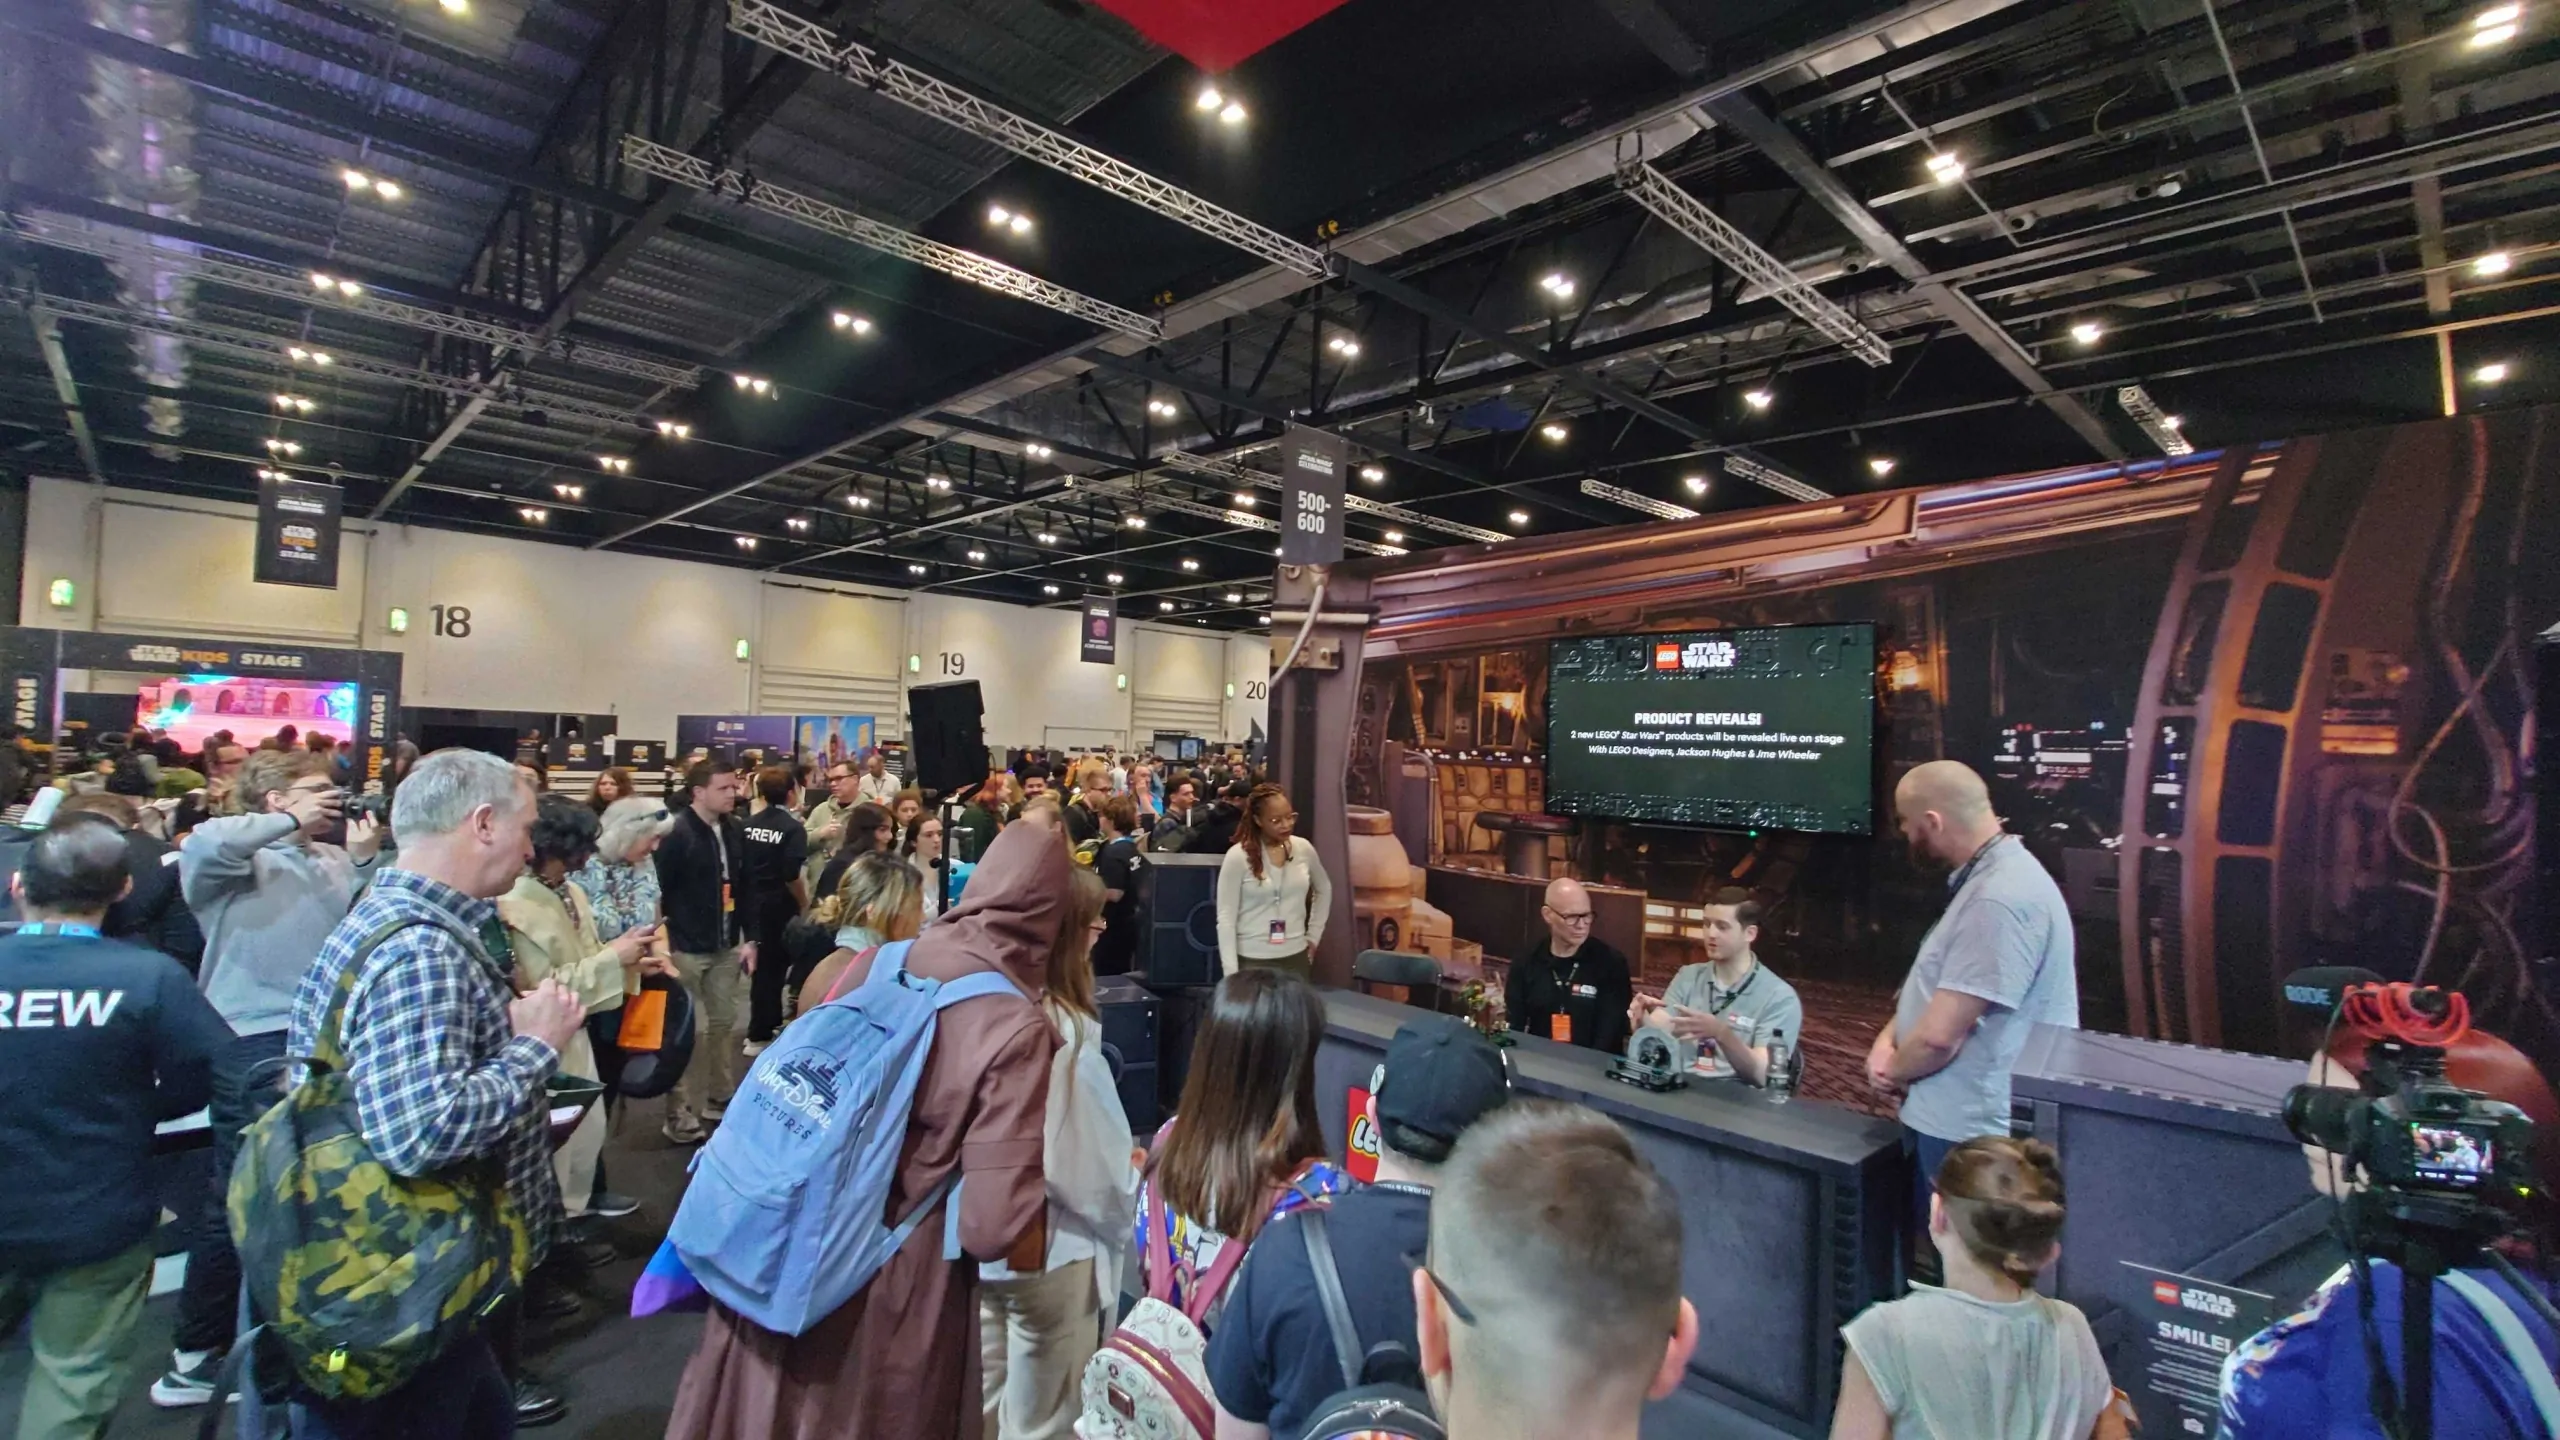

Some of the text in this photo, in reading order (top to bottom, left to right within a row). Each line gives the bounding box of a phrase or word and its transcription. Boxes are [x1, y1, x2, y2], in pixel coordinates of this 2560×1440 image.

[1298, 490, 1332, 513] 500-
[1297, 512, 1325, 534] 600
[430, 604, 471, 638] 18
[181, 650, 230, 663] KIDS
[240, 653, 302, 667] STAGE
[1682, 642, 1735, 656] STAR
[939, 652, 965, 676] 19
[1682, 654, 1735, 668] WARS
[1246, 680, 1267, 700] 20
[15, 678, 37, 729] STAGE
[369, 695, 386, 738] STAGE
[1635, 712, 1762, 725] PRODUCT REVEALS!
[1571, 730, 1577, 739] 2
[1621, 731, 1639, 740] Star
[1665, 731, 1704, 741] products
[1706, 732, 1721, 741] will
[1723, 732, 1735, 741] be
[1737, 732, 1778, 742] revealed
[1780, 733, 1797, 742] live
[1799, 735, 1812, 743] on
[1814, 734, 1844, 745] stage
[1588, 745, 1607, 754] With
[1608, 745, 1631, 754] LEGO
[1632, 746, 1675, 757] Designers,
[1676, 747, 1710, 757] Jackson
[1712, 748, 1746, 759] Hughes
[1748, 749, 1755, 758] &
[1778, 750, 1821, 760] Wheeler
[0, 989, 123, 1027] EW
[753, 1092, 813, 1140] PICTURES
[1351, 1118, 1382, 1154] LE
[2158, 1321, 2232, 1353] SMILE!
